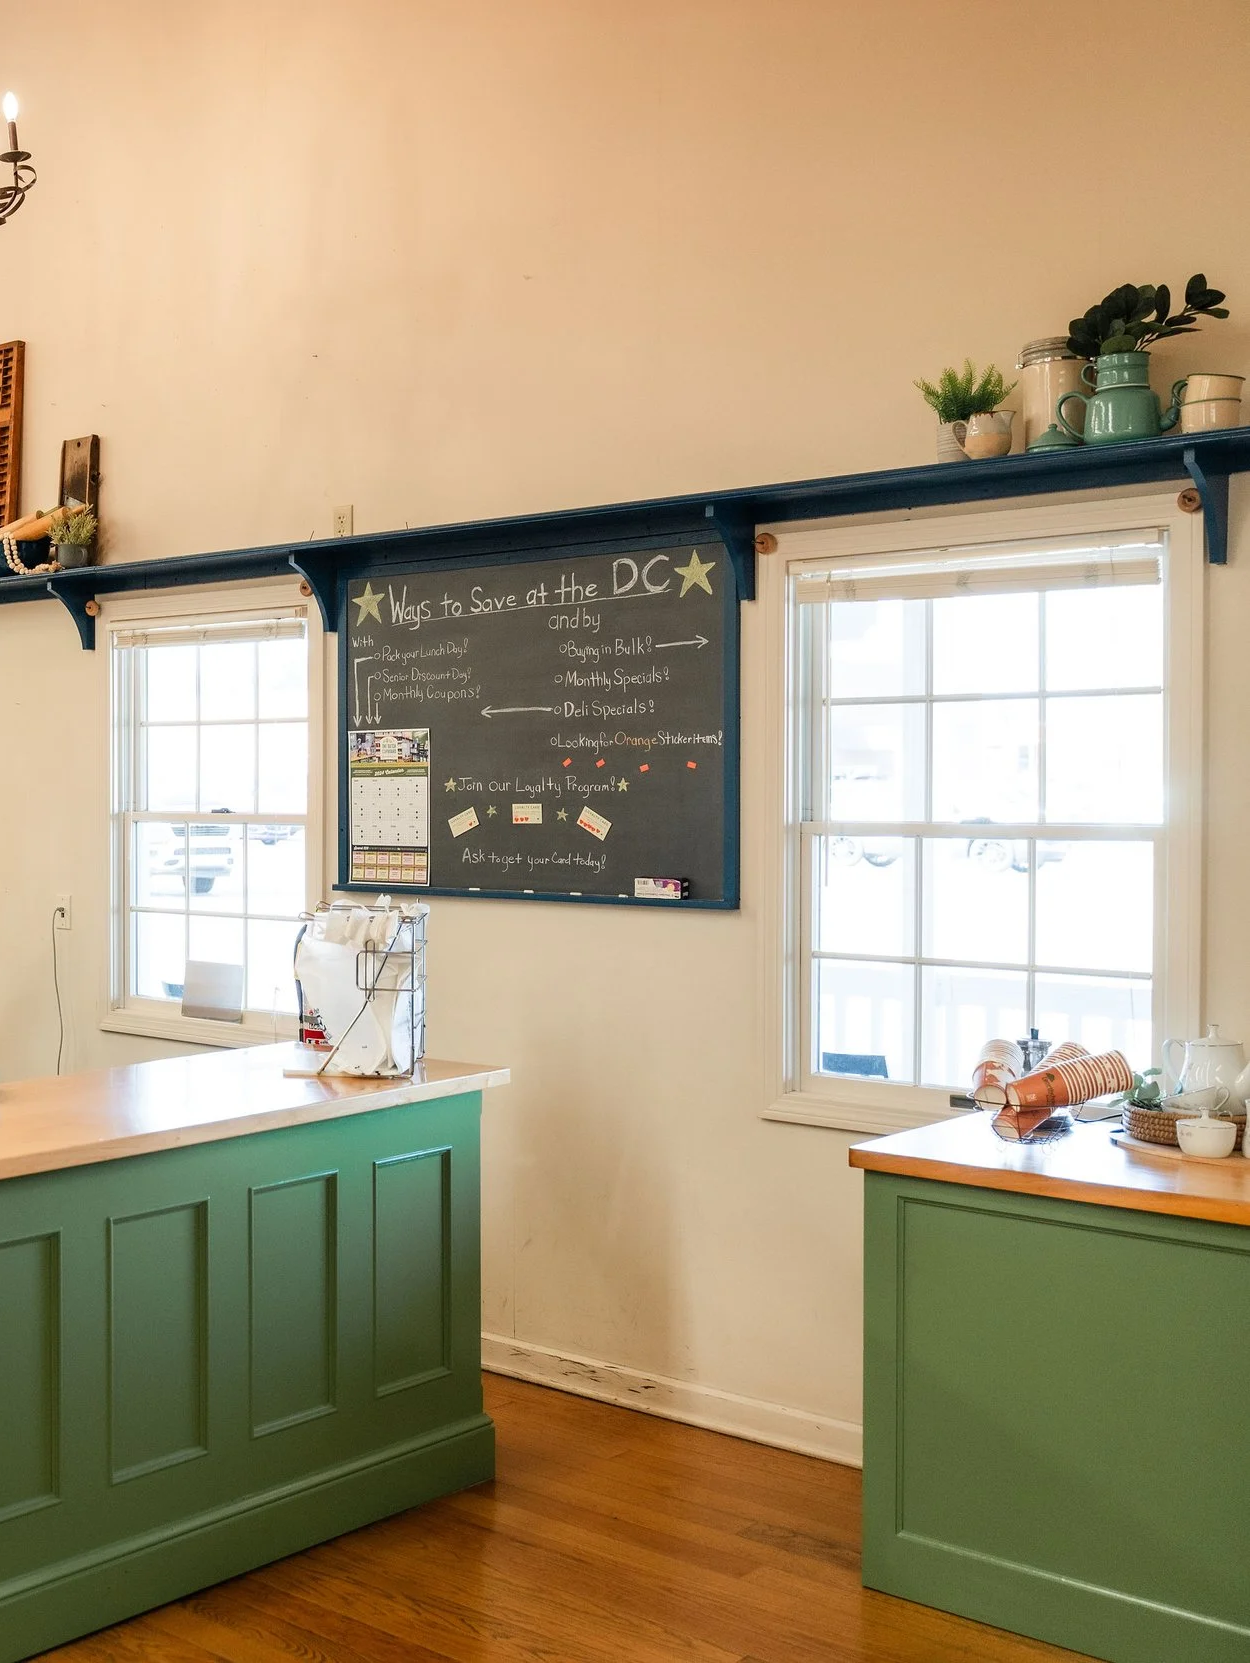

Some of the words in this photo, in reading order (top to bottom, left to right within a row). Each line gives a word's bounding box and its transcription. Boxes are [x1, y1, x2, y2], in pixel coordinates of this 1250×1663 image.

[389, 584, 431, 630] Ways
[440, 592, 462, 616] to
[470, 586, 517, 613] Save
[526, 583, 549, 605] at
[554, 573, 598, 603] the
[612, 554, 671, 595] DC
[548, 608, 580, 631] and
[583, 608, 600, 633] by
[352, 635, 374, 648] With
[382, 645, 401, 662] Pack
[402, 651, 419, 665] your
[420, 644, 445, 658] Lunch
[447, 638, 469, 658] Day!
[568, 640, 600, 663] Buying
[601, 644, 612, 655] in
[616, 636, 652, 656] Bulk!
[382, 668, 409, 684] Senior
[412, 667, 451, 682] Discount
[564, 670, 611, 692] Monthly
[614, 666, 670, 693] Specials!
[384, 686, 424, 702] Monthly
[426, 684, 481, 703] Coupons!
[564, 700, 589, 718] Deli
[592, 698, 655, 720] Specials!
[558, 733, 599, 755] Looking
[600, 732, 613, 748] for
[614, 731, 658, 752] Orange
[658, 730, 692, 746] Sticker
[458, 777, 483, 792] Join
[516, 776, 561, 799] Loyalty
[566, 776, 617, 799] Program!
[462, 848, 485, 863] Ask
[488, 852, 501, 863] to
[502, 853, 523, 873] get
[527, 855, 550, 872] your
[552, 852, 571, 866] Card
[573, 852, 607, 874] today!
